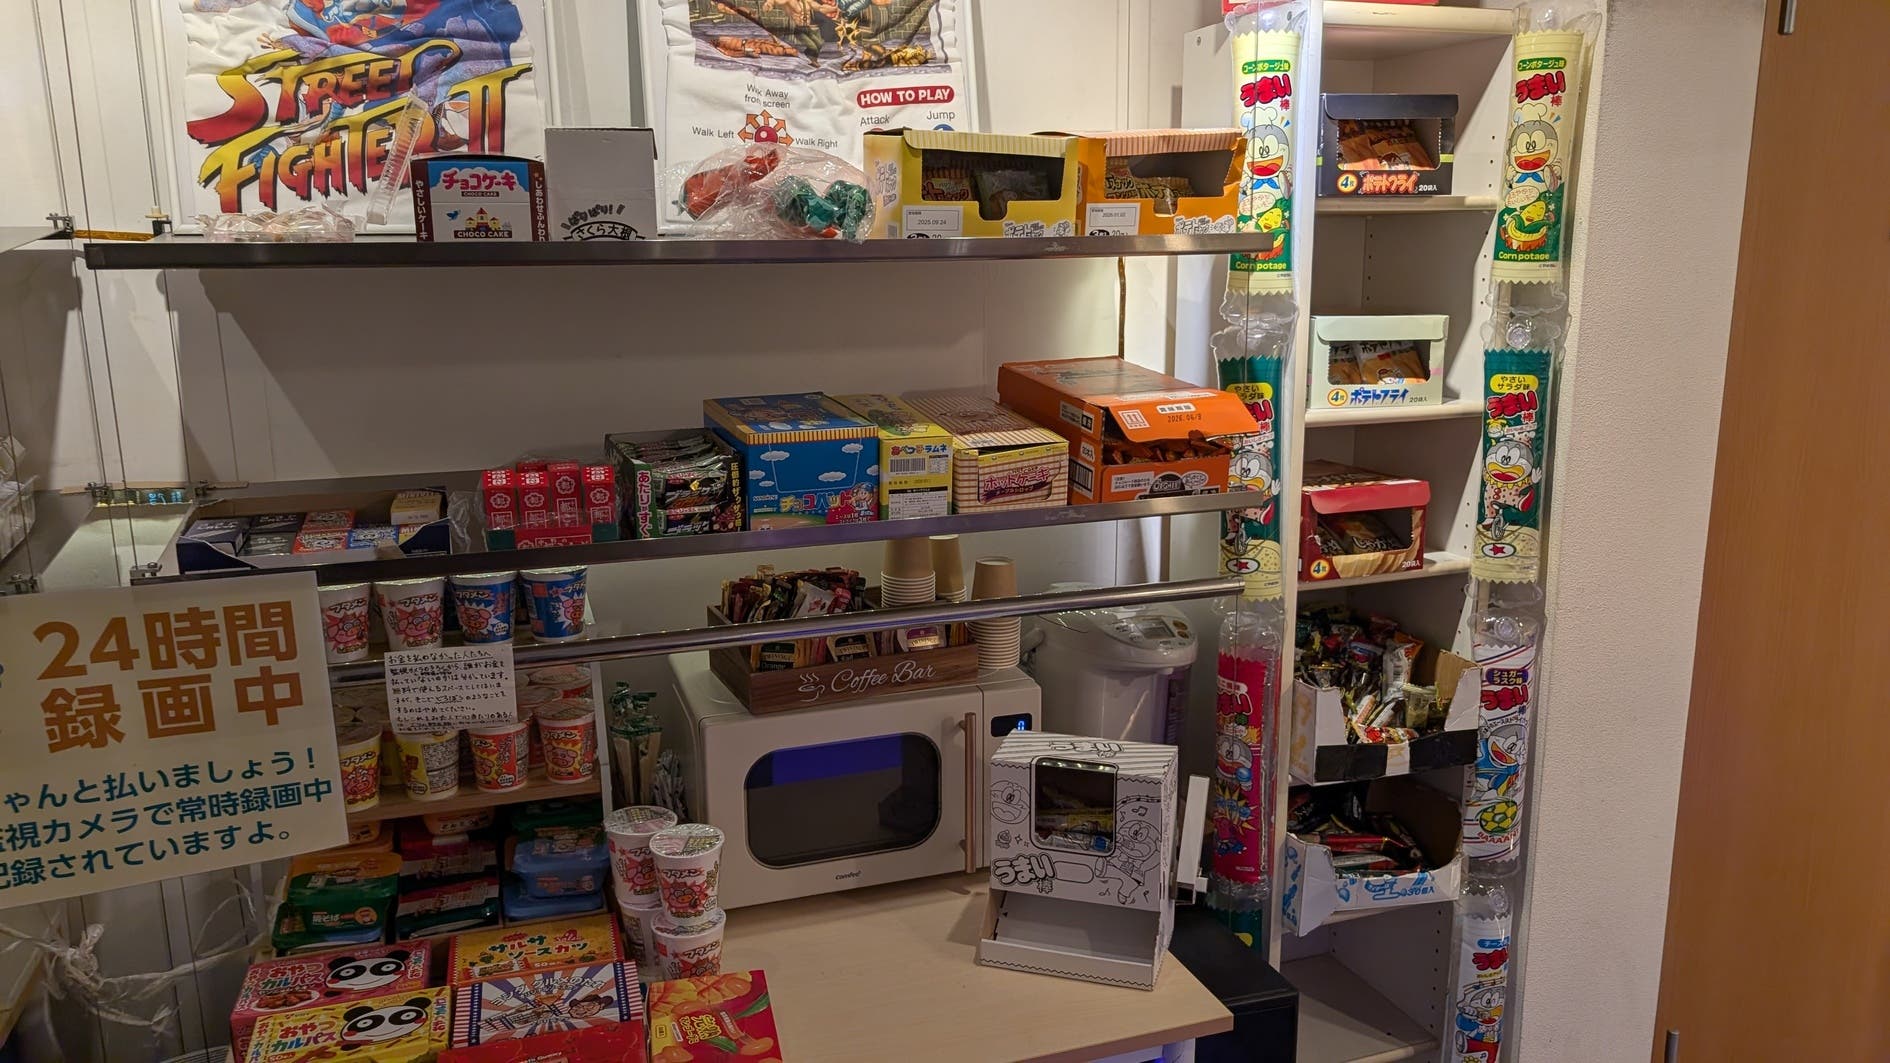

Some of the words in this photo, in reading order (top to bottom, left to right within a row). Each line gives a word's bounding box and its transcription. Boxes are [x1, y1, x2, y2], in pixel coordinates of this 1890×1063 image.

[187, 39, 463, 147] STREET
[765, 89, 789, 101] Away
[1240, 73, 1292, 107] うまい
[1515, 71, 1566, 104] うまい
[762, 98, 791, 110] screen
[860, 93, 892, 106] HOW
[897, 91, 915, 103] TO
[918, 88, 950, 102] PLAY
[860, 114, 890, 126] Attack
[926, 110, 956, 122] Jump
[692, 126, 714, 138] Walk
[717, 129, 735, 140] Left
[795, 137, 816, 148] Walk
[817, 138, 838, 149] Right
[198, 97, 438, 213] FIGHTER
[442, 170, 517, 191] チョコケーキ
[1362, 173, 1418, 195] ポテトフライ
[415, 180, 429, 240] やさしいケーキ
[575, 223, 634, 240] さくら大根
[1498, 251, 1518, 260] Corn
[1518, 252, 1550, 261] potage
[1235, 261, 1256, 269] Corn
[1257, 262, 1287, 271] potage
[1497, 383, 1531, 391] サラダ味
[1500, 375, 1526, 384] やさい
[1240, 391, 1265, 401] ラダ味
[1350, 387, 1409, 406] ポテトフライ
[1487, 390, 1538, 419] うまい
[983, 466, 1050, 491] ホットケーキ
[780, 490, 853, 513] チョコバット
[33, 600, 298, 680] 24時間
[831, 669, 888, 694] Coffee
[891, 660, 937, 683] Bar
[1493, 670, 1523, 678] シュガー
[1481, 684, 1529, 711] うまい
[40, 666, 304, 753] 録画中
[662, 869, 701, 879] ブタメン
[992, 853, 1055, 885] うまい
[1037, 878, 1054, 894] 棒
[489, 936, 547, 953] サルサ
[269, 961, 324, 978] おやつ
[259, 974, 324, 990] カルパス
[279, 1019, 338, 1039] おやつ
[270, 1033, 337, 1052] カルパス
